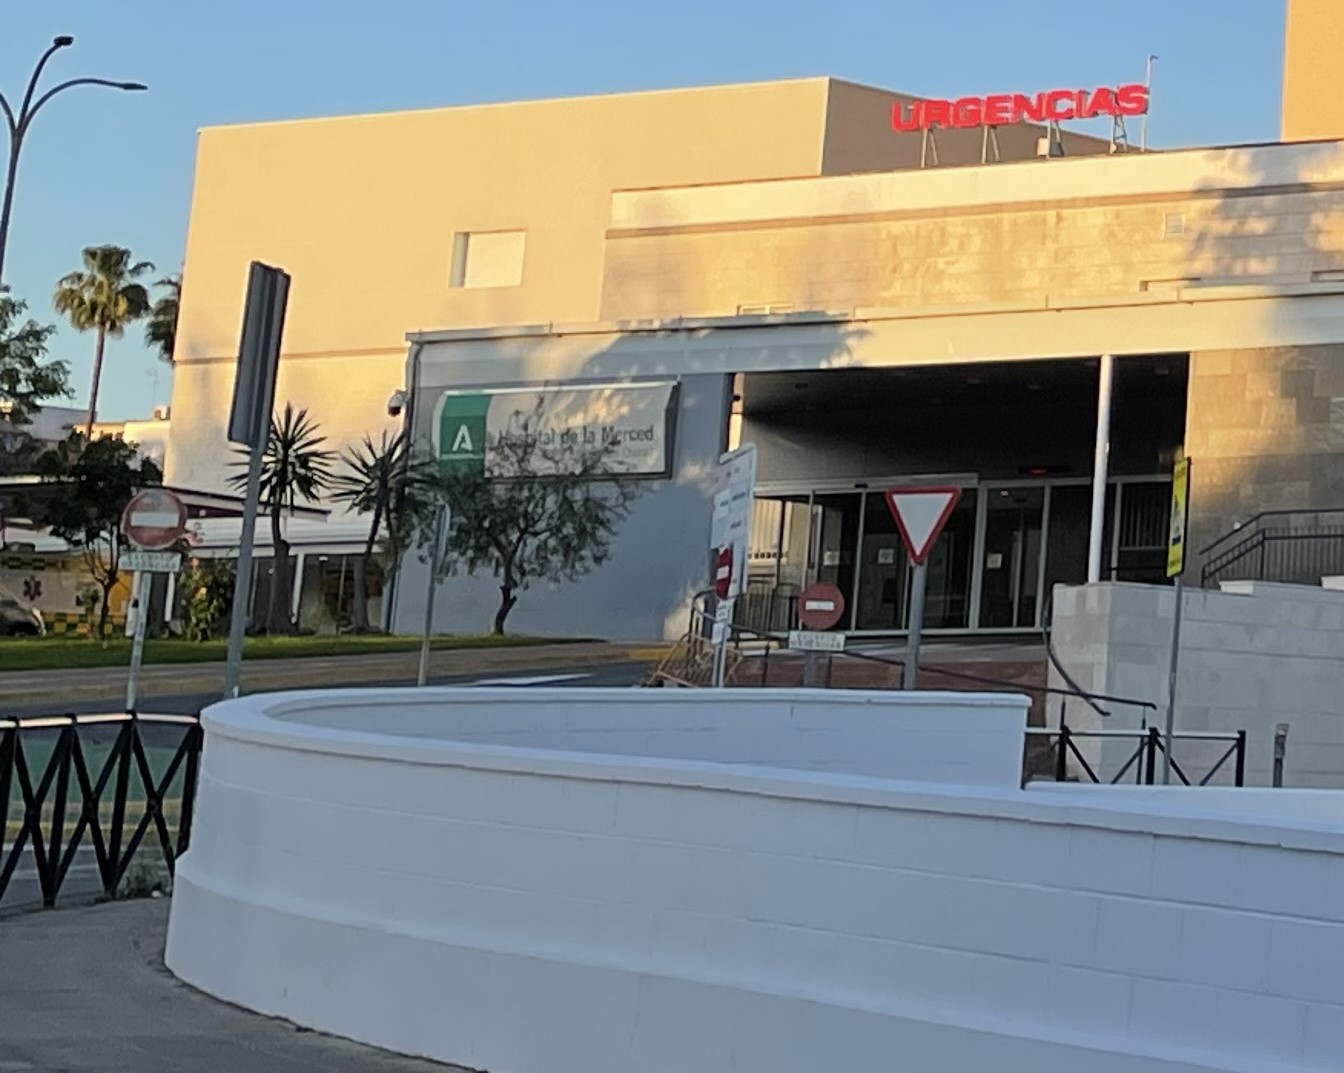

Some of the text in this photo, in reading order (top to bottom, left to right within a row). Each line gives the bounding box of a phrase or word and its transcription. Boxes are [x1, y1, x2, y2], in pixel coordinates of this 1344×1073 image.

[890, 83, 1150, 133] URGENCIAS
[561, 427, 579, 444] de
[583, 425, 595, 443] la
[601, 424, 654, 445] Merced
